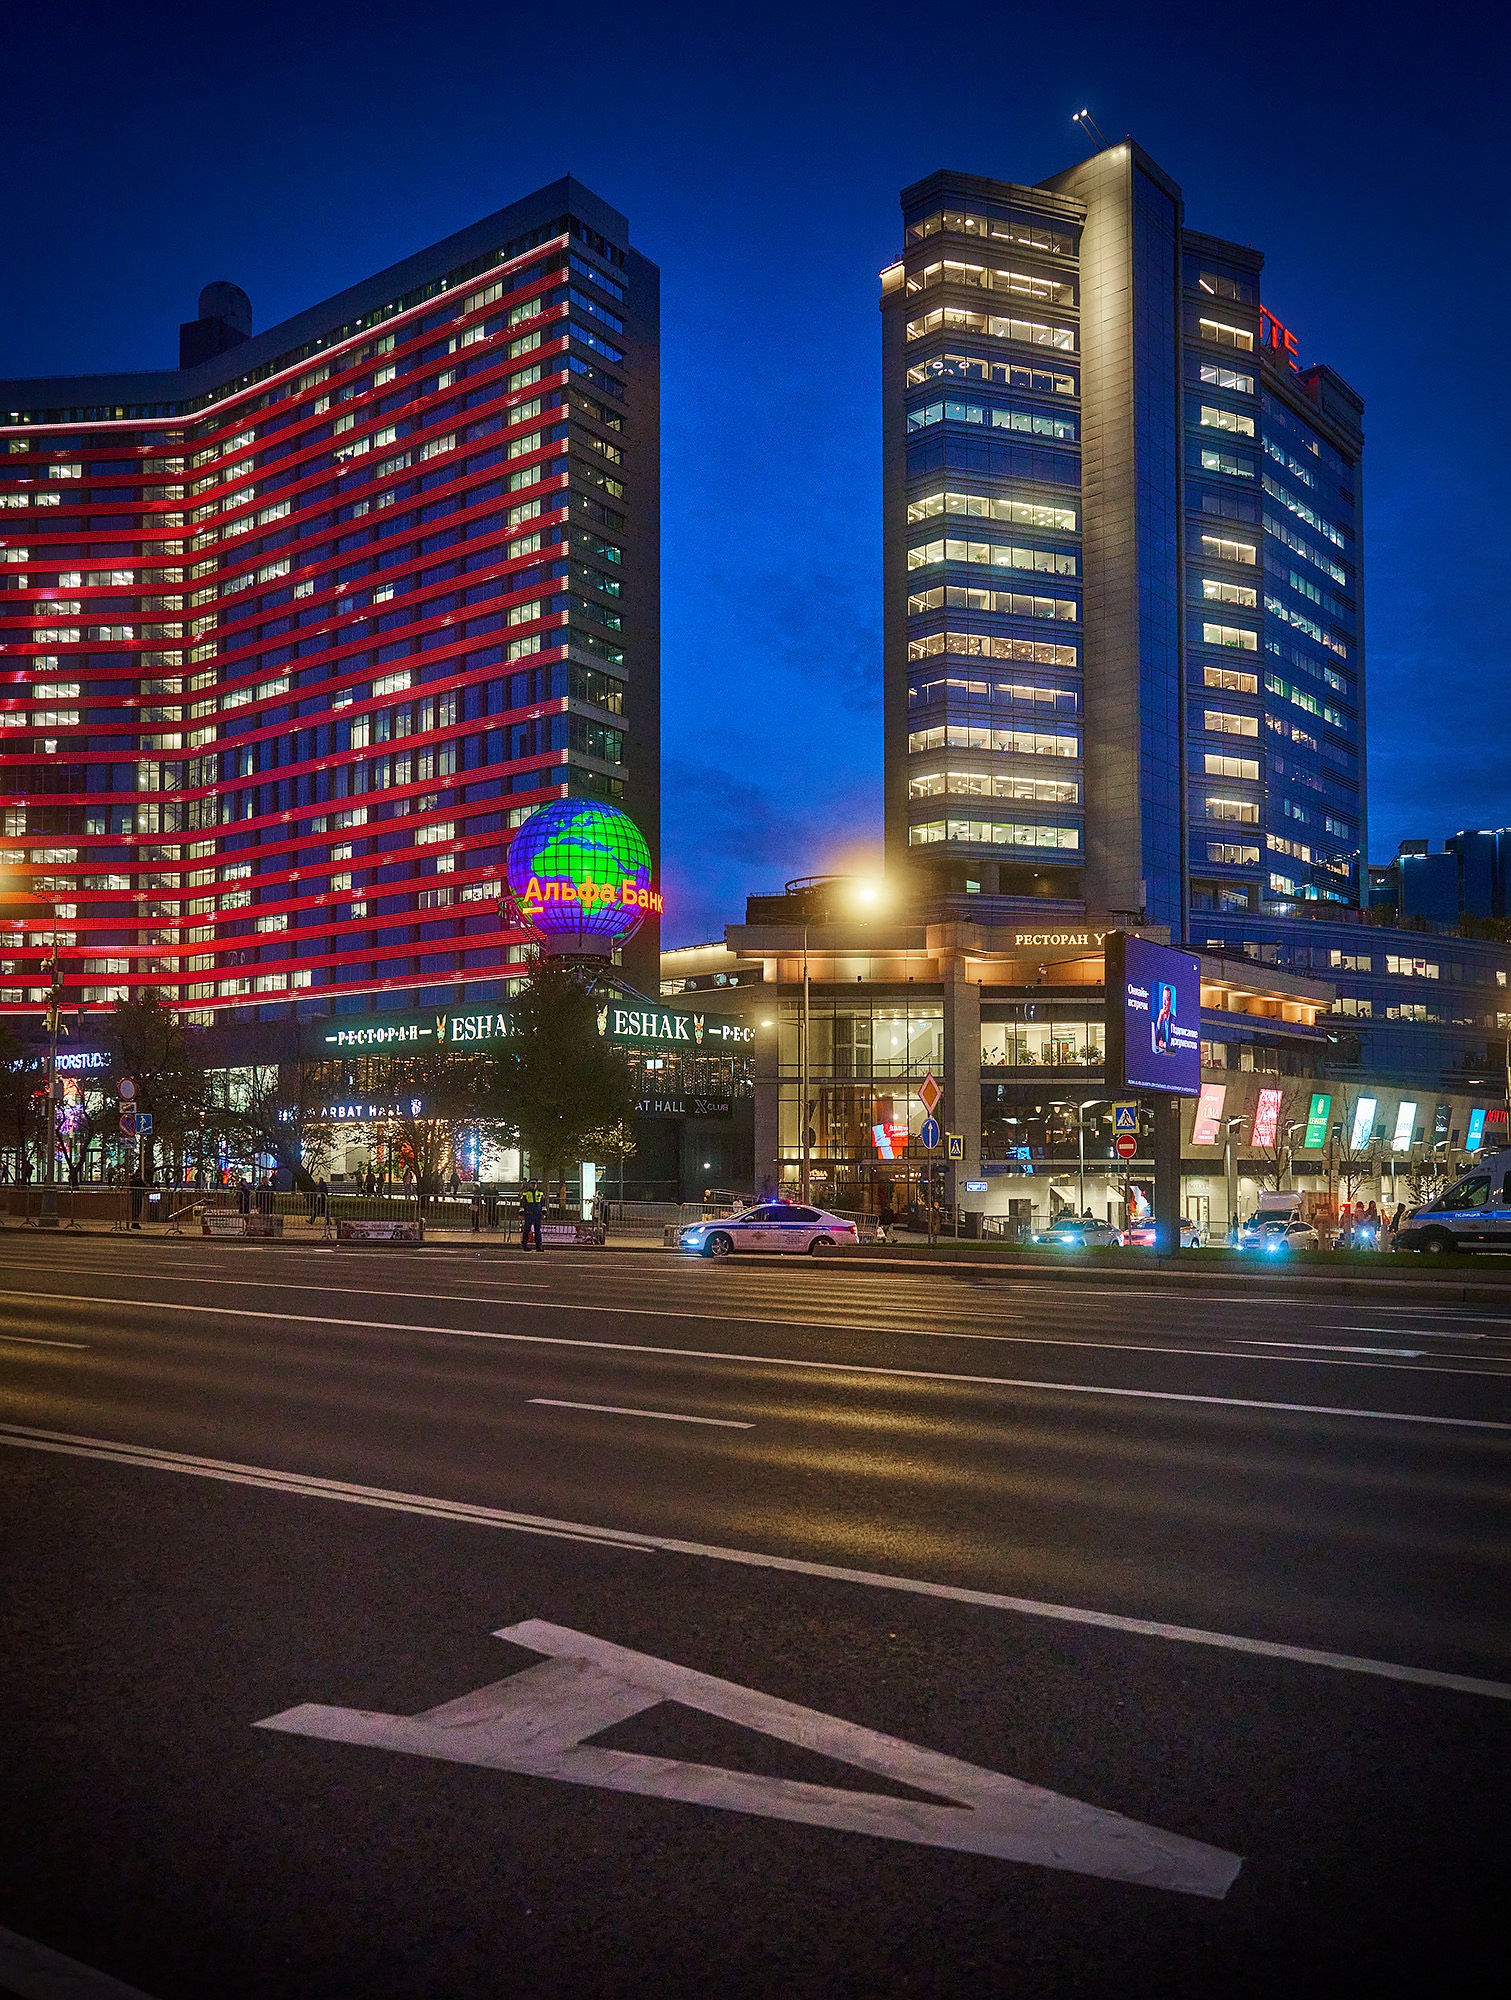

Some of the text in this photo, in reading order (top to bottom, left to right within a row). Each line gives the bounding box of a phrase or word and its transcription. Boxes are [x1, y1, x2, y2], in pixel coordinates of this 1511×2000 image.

[523, 876, 665, 914] Альфа Банк
[1015, 934, 1088, 945] РЕСТОРАН
[614, 1009, 690, 1041] ESHAK
[320, 1106, 363, 1118] ARBAT
[655, 1101, 685, 1113] HALL
